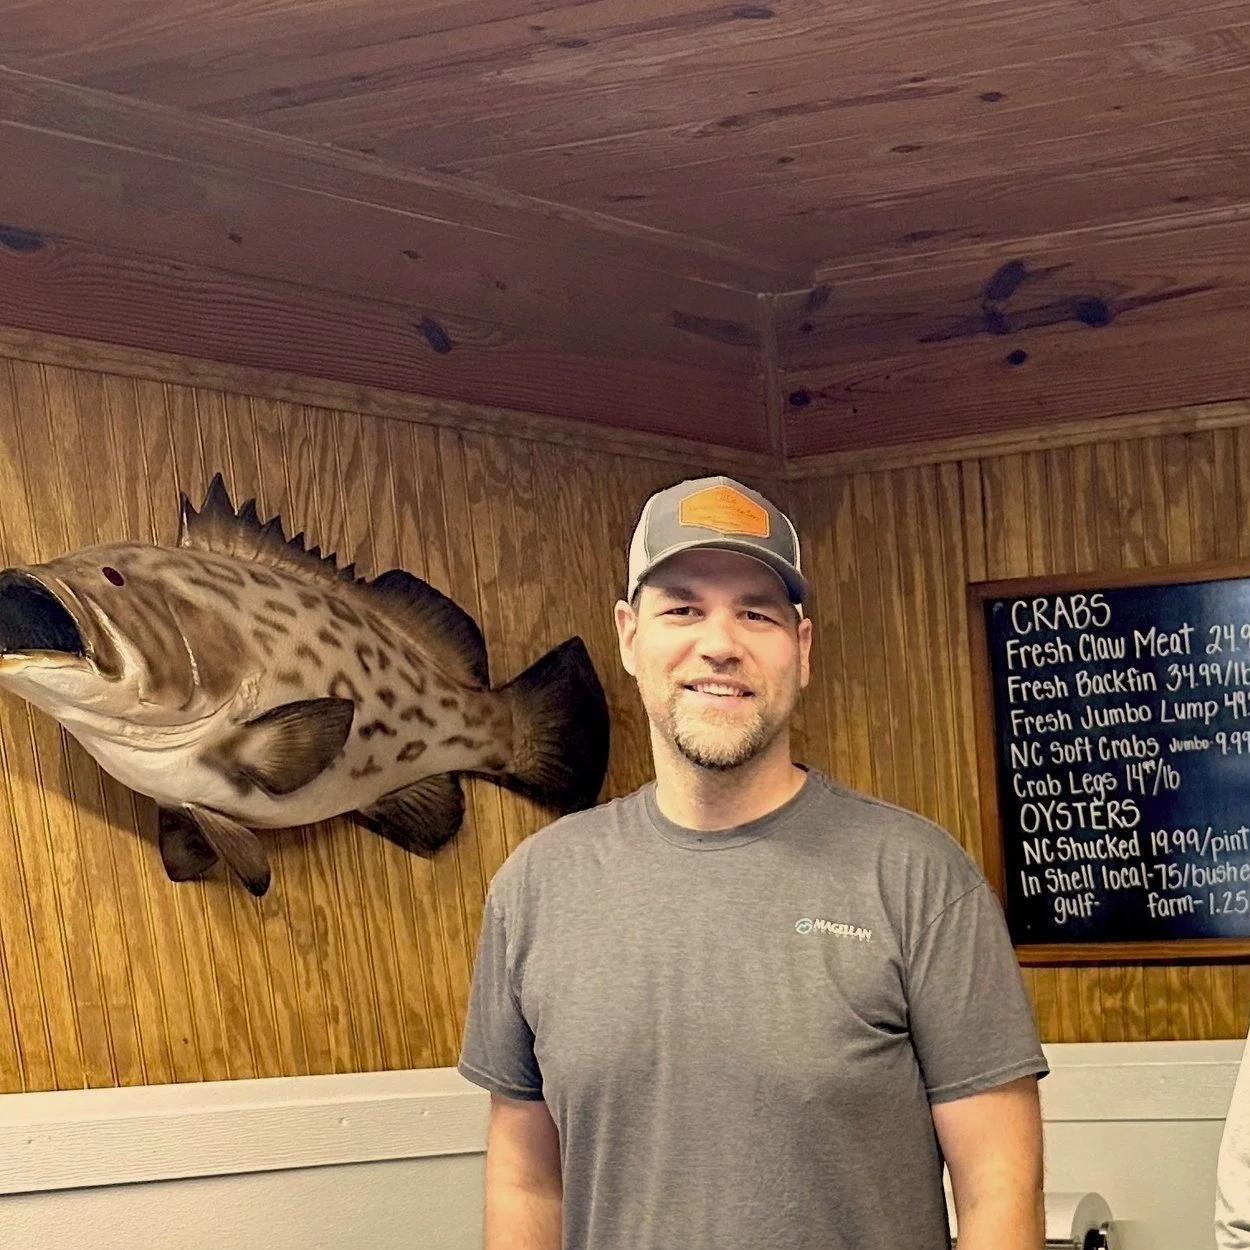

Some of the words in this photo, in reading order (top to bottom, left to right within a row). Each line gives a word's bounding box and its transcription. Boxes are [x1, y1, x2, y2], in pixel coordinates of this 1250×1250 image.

[1011, 594, 1111, 635] CRABS
[1006, 636, 1074, 670] Fresh
[1079, 633, 1125, 662] Claw
[1133, 622, 1195, 659] Meat
[1007, 674, 1069, 704] Fresh
[1075, 667, 1157, 698] Backfin
[1010, 709, 1073, 737] Fresh
[1080, 702, 1151, 730] Jumbo
[1160, 700, 1219, 725] Lump
[1010, 741, 1044, 769] NC
[1098, 734, 1160, 761] Crabs
[1013, 772, 1062, 798] Crab
[1069, 770, 1118, 803] Legs
[1020, 799, 1141, 834] OYSTERS
[1022, 837, 1055, 865] NC
[1056, 830, 1141, 862] Shucked
[1151, 826, 1250, 863] 19.99/pint
[1021, 870, 1042, 898] In
[1044, 863, 1095, 893] Shell
[813, 918, 872, 943] MAGELLAN
